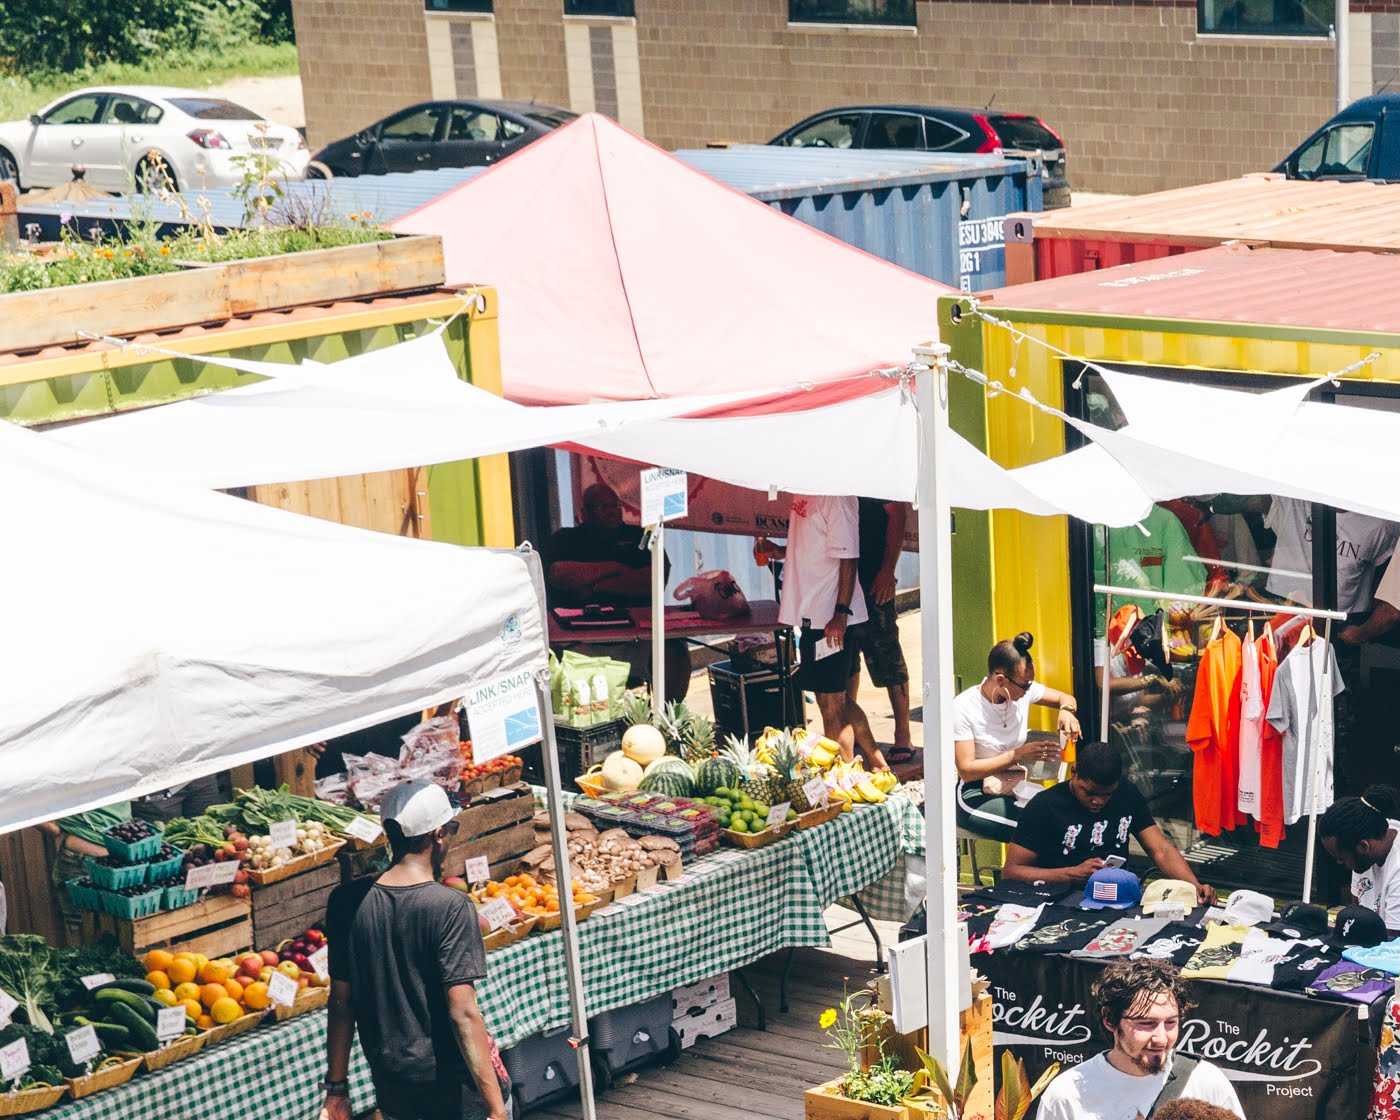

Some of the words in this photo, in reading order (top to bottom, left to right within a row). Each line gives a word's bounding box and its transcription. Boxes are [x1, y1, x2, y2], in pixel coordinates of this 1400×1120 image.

[994, 986, 1017, 1001] The
[992, 994, 1092, 1045] ockit
[1216, 1020, 1240, 1036] The
[1044, 1047, 1084, 1064] Project
[1174, 1019, 1322, 1076] Rockit
[1266, 1084, 1313, 1098] Project
